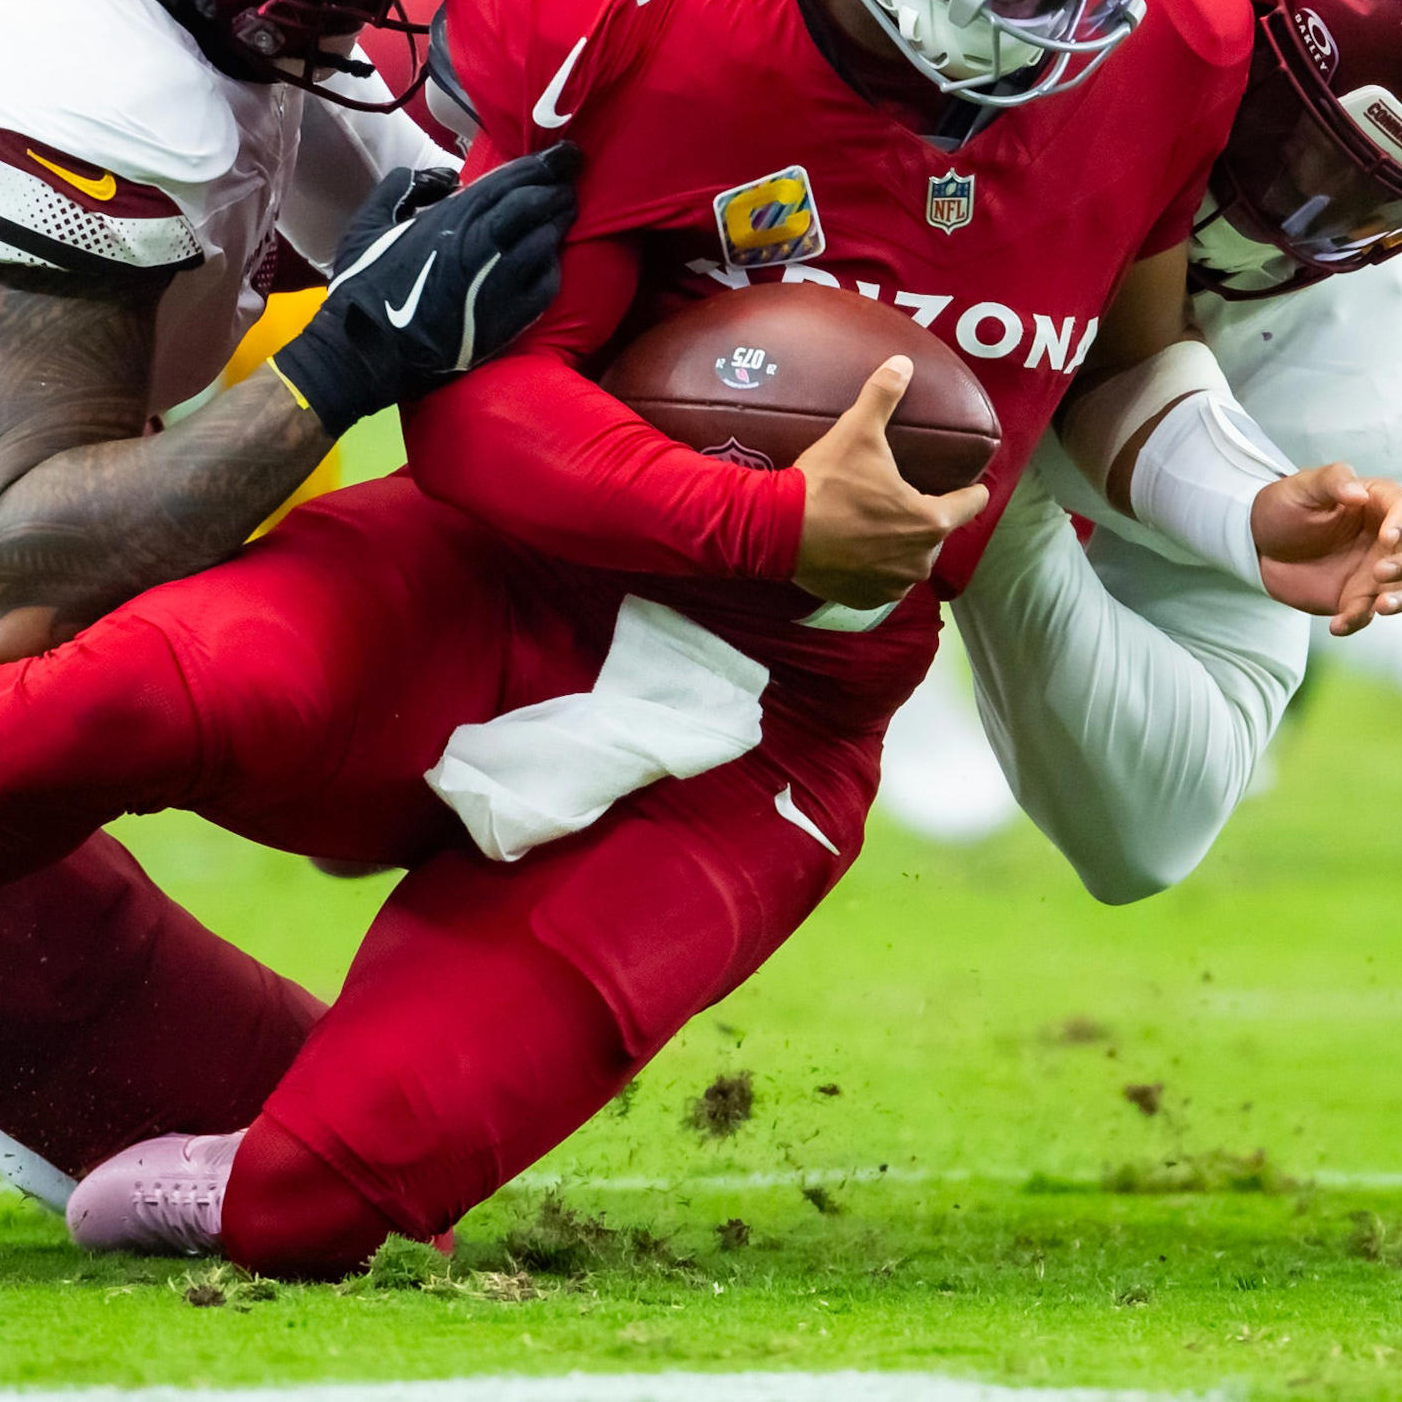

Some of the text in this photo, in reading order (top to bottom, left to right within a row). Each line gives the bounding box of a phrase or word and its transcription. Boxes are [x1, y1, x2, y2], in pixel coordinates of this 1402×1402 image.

[1294, 12, 1329, 73] OAKLEY
[725, 179, 811, 249] C
[933, 199, 966, 220] NFL
[731, 347, 765, 370] 075
